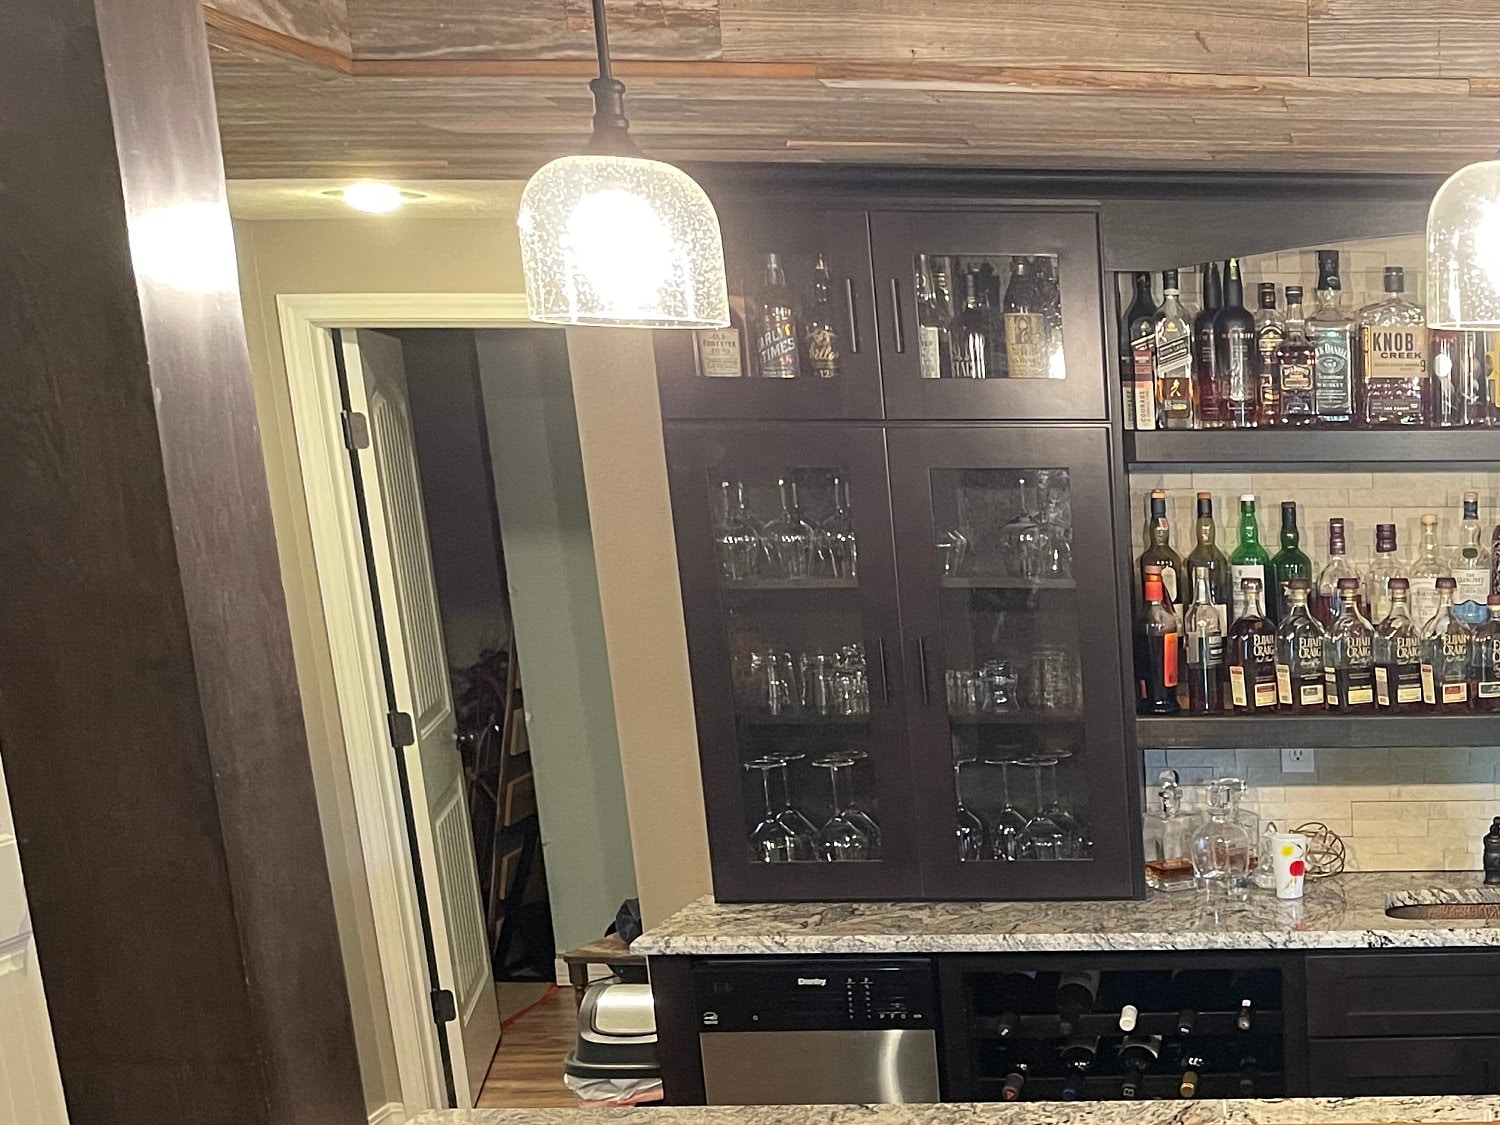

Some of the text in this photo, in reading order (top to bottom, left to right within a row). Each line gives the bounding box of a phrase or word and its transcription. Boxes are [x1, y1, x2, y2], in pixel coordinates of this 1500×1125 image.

[1373, 333, 1414, 352] KNOB
[761, 338, 795, 363] TIMES
[1420, 359, 1426, 372] 9
[1253, 634, 1274, 645] ELIJAH
[1253, 644, 1274, 657] CRAIG
[1346, 646, 1370, 658] CRAIG
[1396, 646, 1420, 658] CRAIG
[1443, 644, 1466, 656] CRAIG
